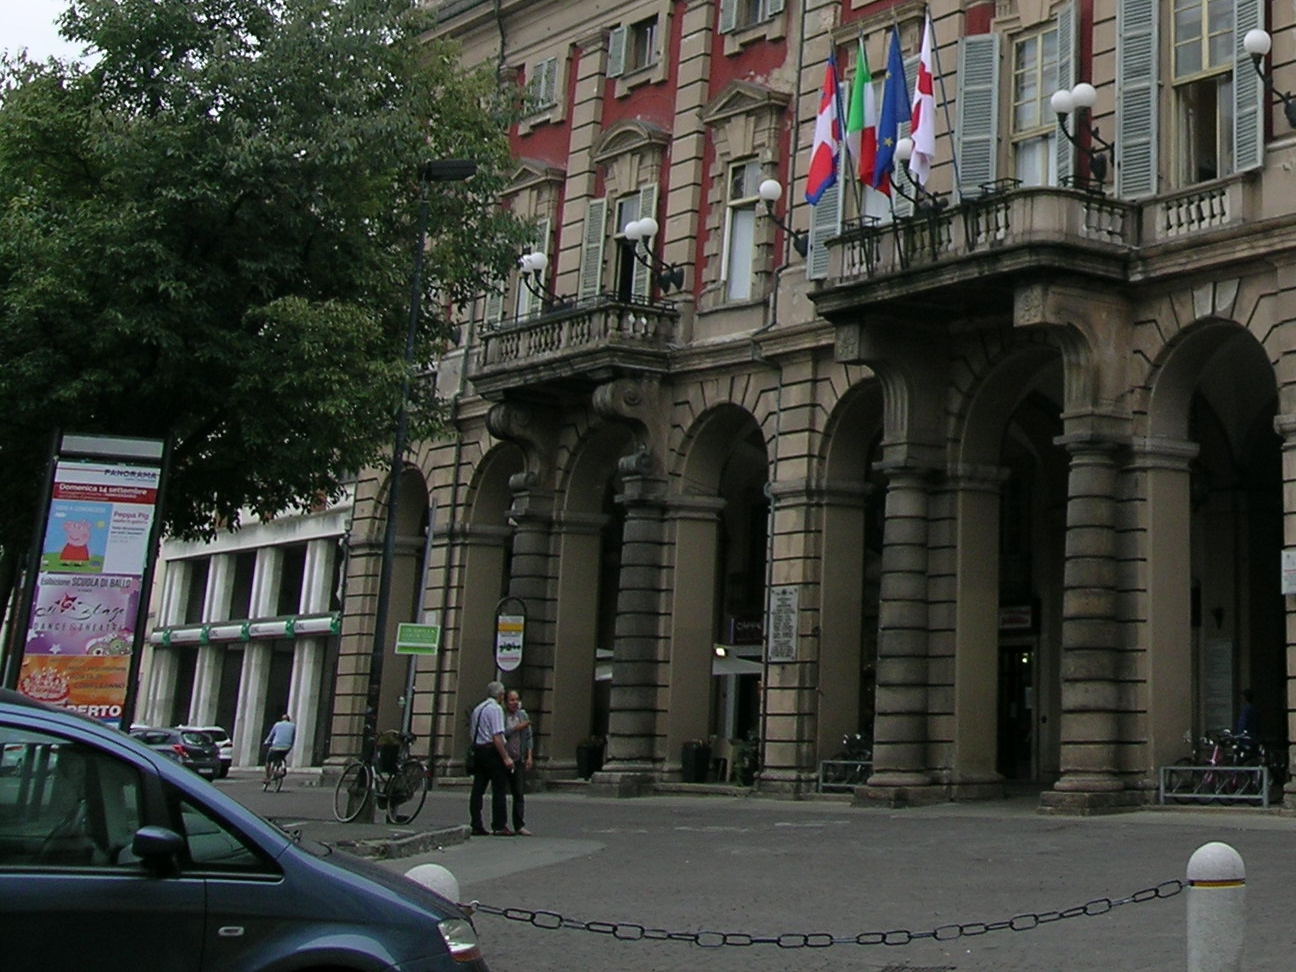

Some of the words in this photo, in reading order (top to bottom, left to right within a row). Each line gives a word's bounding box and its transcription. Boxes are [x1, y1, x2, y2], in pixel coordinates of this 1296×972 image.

[104, 469, 157, 478] PANORAMA
[59, 483, 97, 492] Domenica
[108, 486, 148, 495] settembre
[113, 511, 136, 520] Peppa
[137, 512, 150, 521] Pig
[72, 577, 99, 587] SCUOLA
[110, 578, 131, 588] BALLO
